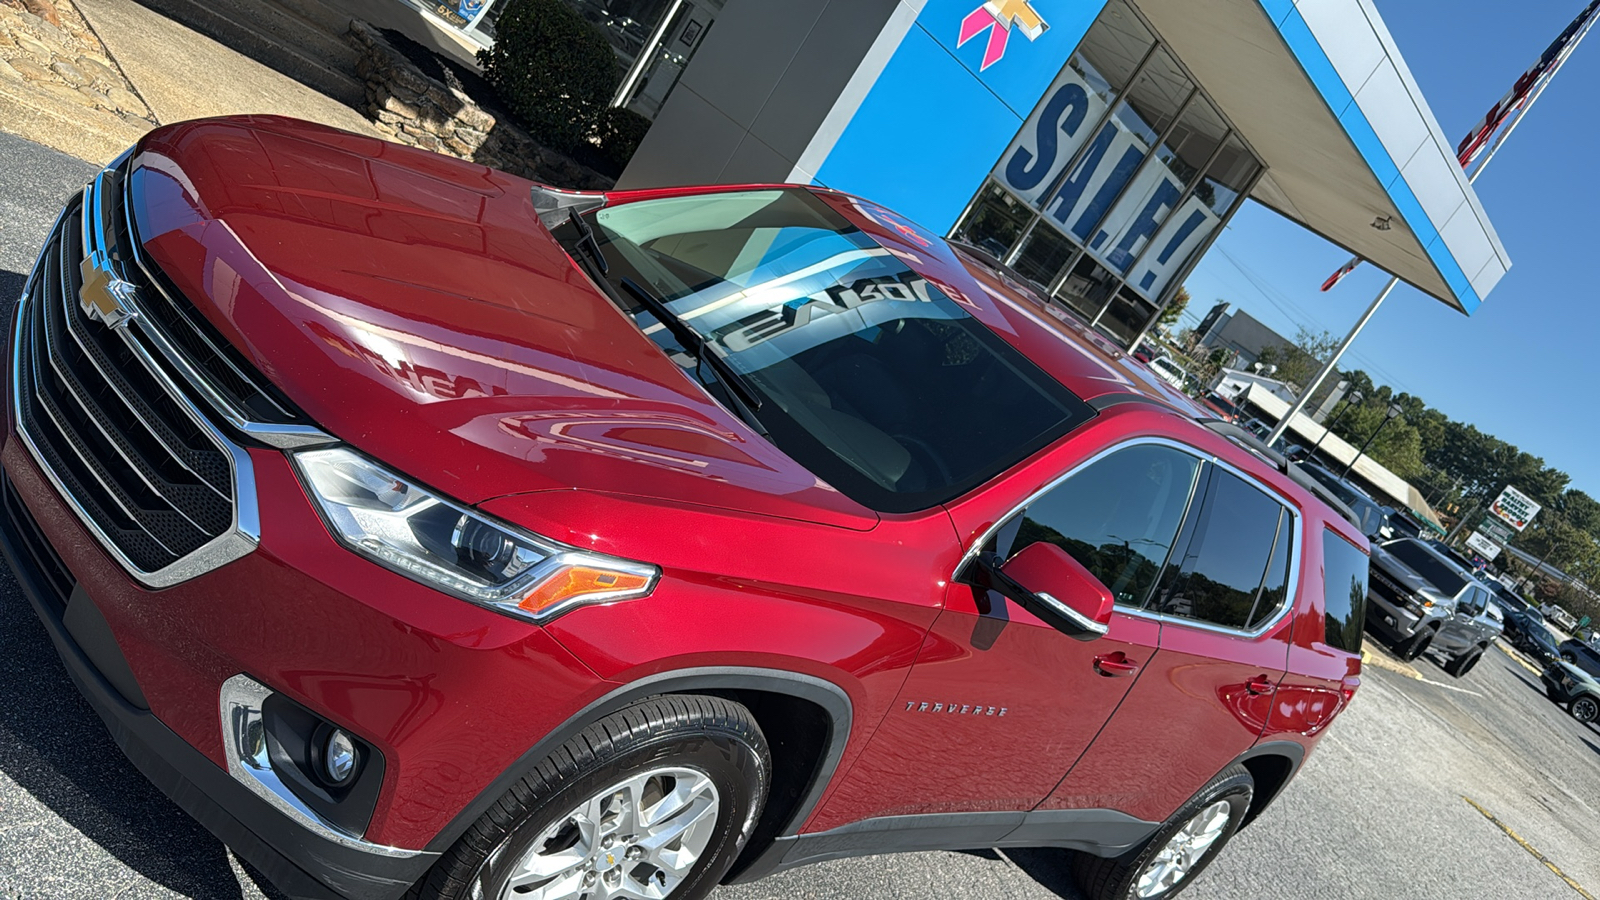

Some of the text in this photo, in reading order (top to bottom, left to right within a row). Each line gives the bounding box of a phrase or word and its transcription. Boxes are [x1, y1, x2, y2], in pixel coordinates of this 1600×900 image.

[1005, 83, 1207, 291] SALE!
[1501, 497, 1529, 517] HARVEST
[1502, 491, 1529, 510] HEALTHY
[905, 701, 1008, 717] TRAVERSE
